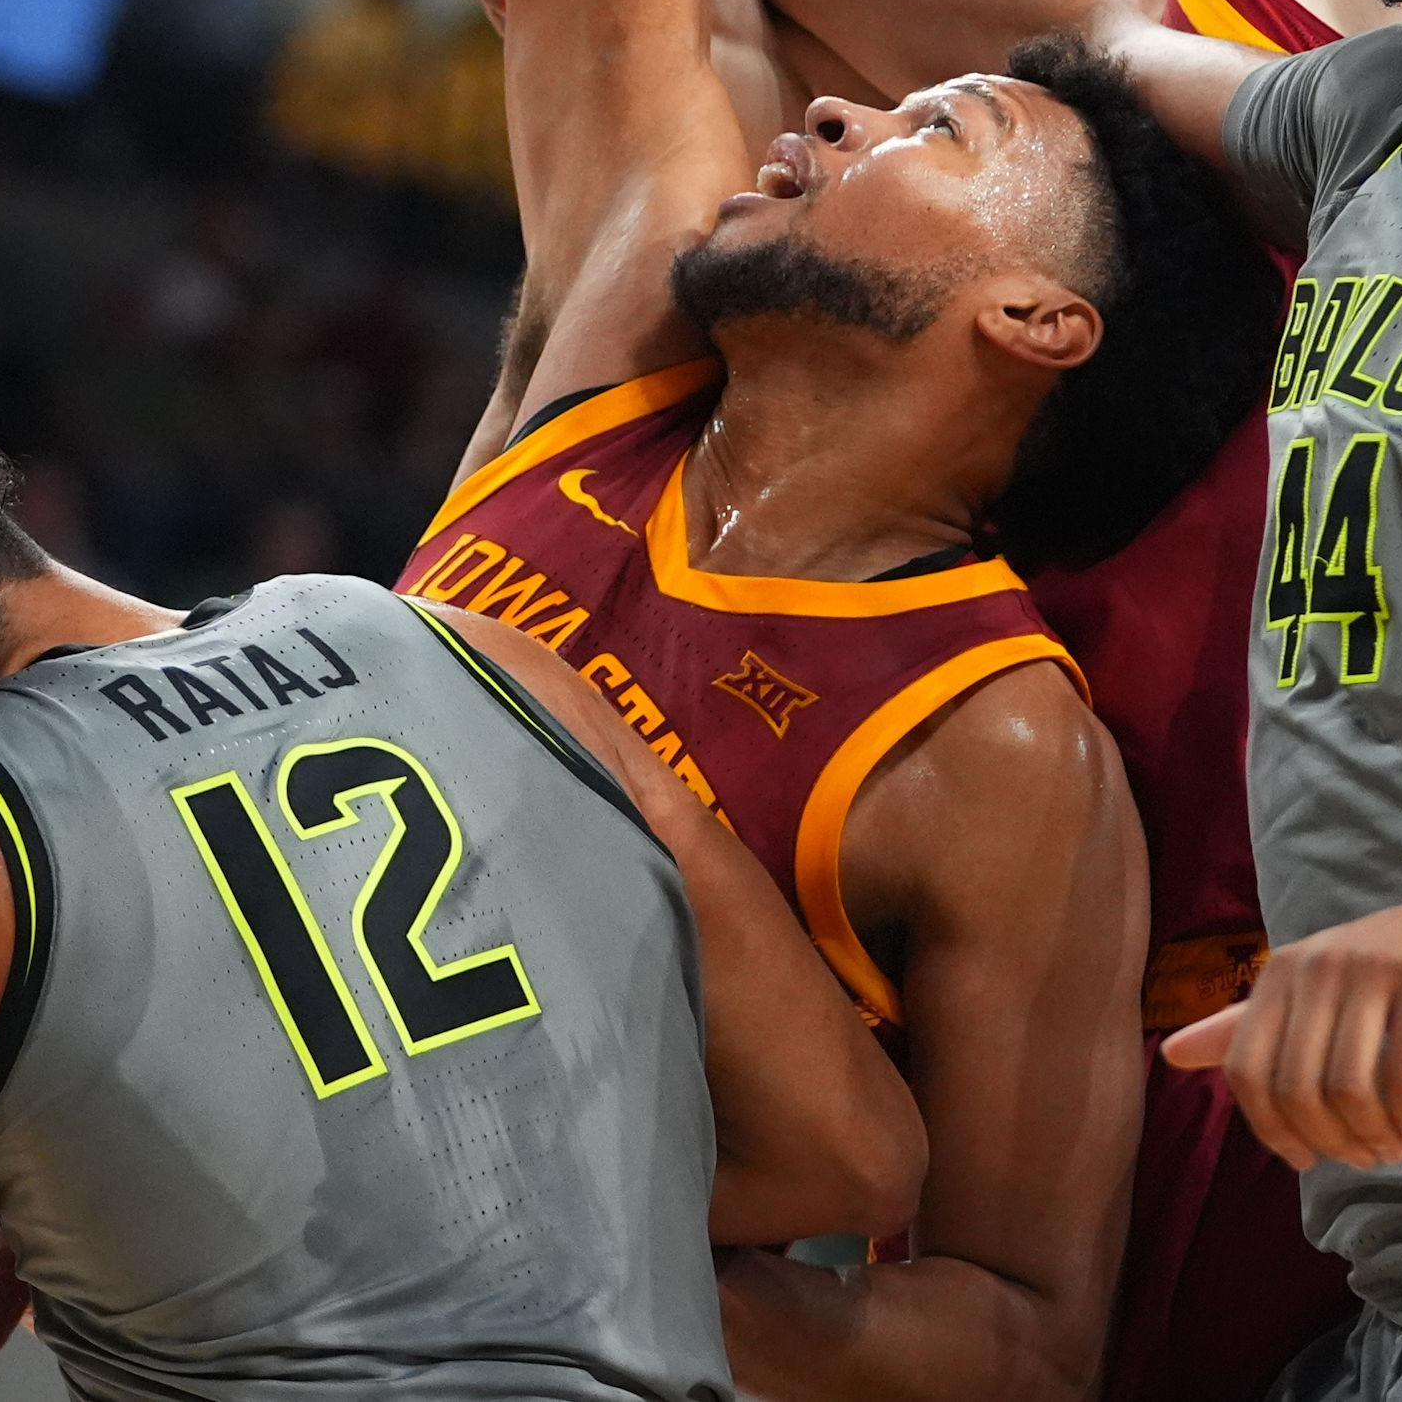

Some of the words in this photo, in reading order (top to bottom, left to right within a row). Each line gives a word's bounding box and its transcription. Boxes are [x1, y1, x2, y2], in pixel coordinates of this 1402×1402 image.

[406, 533, 591, 653] IOWA
[1266, 433, 1390, 688] 44
[99, 627, 360, 742] RATAJ
[170, 736, 542, 1100] 12
[1198, 959, 1266, 1000] STA
